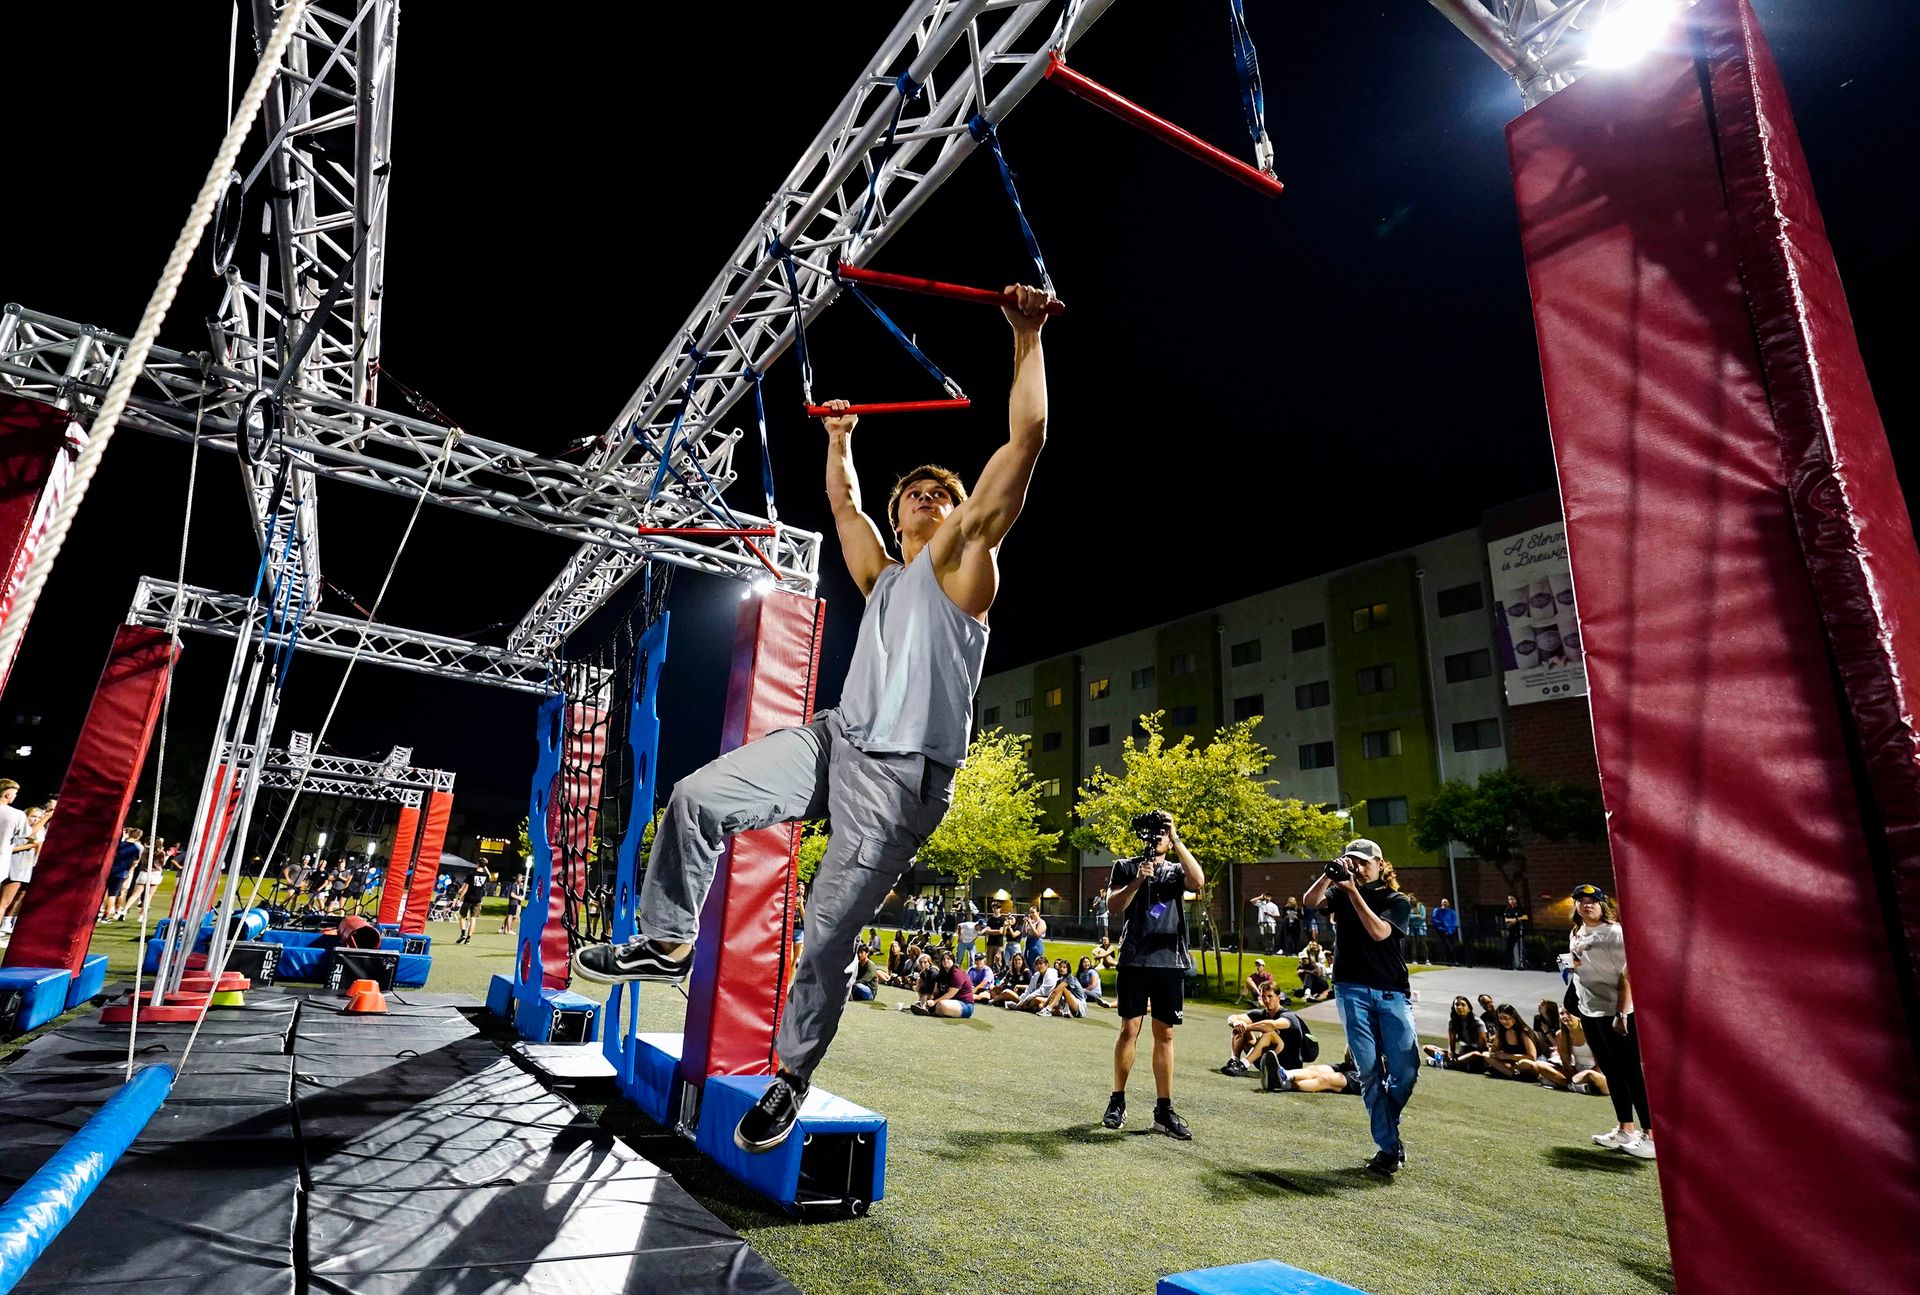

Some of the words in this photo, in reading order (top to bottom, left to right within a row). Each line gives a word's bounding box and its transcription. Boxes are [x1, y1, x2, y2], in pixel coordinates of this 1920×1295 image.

[1502, 560, 1511, 571] is
[1514, 546, 1568, 568] Brewin
[1504, 537, 1524, 555] A
[260, 950, 274, 980] REP
